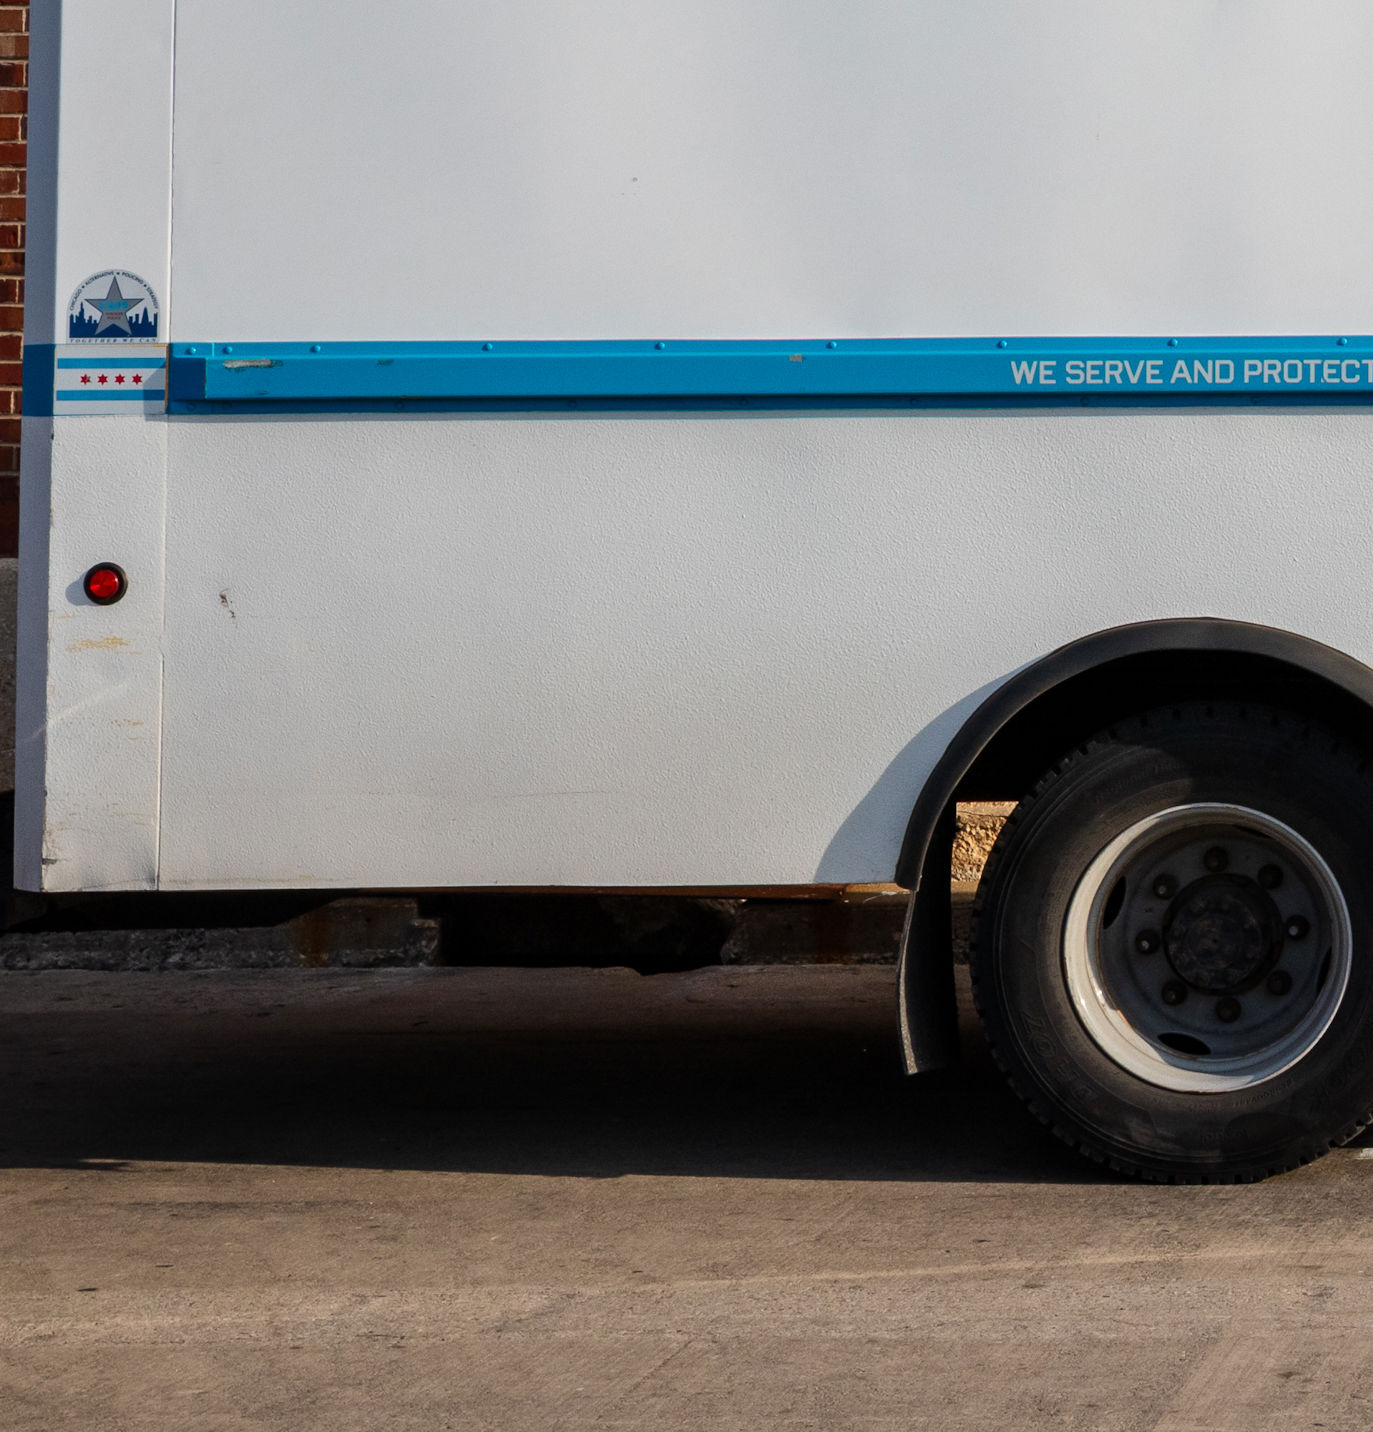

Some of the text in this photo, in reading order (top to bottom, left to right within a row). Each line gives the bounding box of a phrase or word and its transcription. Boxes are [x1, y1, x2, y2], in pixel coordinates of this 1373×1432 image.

[1010, 360, 1057, 385] WE
[1065, 360, 1163, 385] SERVE
[1170, 360, 1234, 384] AND
